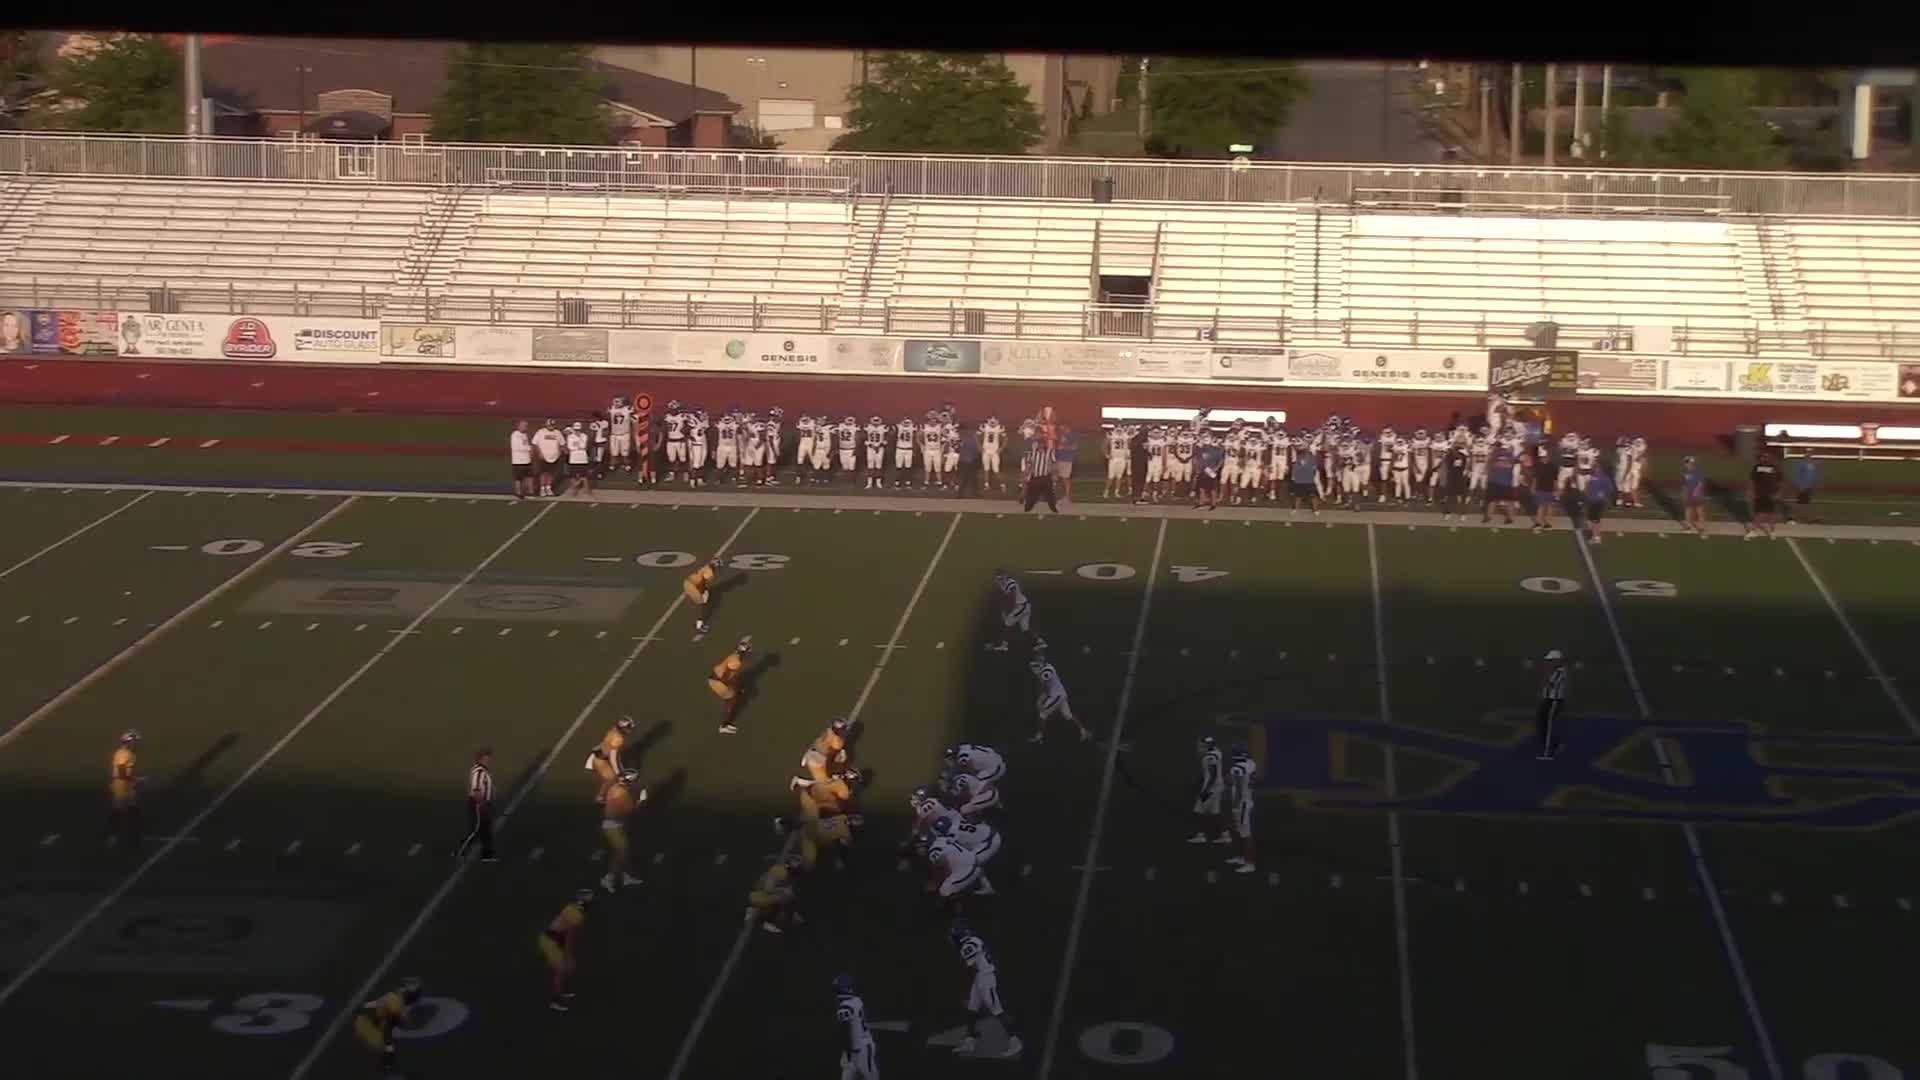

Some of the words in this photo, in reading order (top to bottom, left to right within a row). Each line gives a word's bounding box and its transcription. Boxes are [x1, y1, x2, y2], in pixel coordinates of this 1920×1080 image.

[314, 330, 378, 339] DISCOUNT
[313, 340, 340, 348] AUTO
[761, 354, 818, 362] GENESIS
[1352, 370, 1411, 378] GENESIS
[1420, 372, 1479, 380] GENESIS
